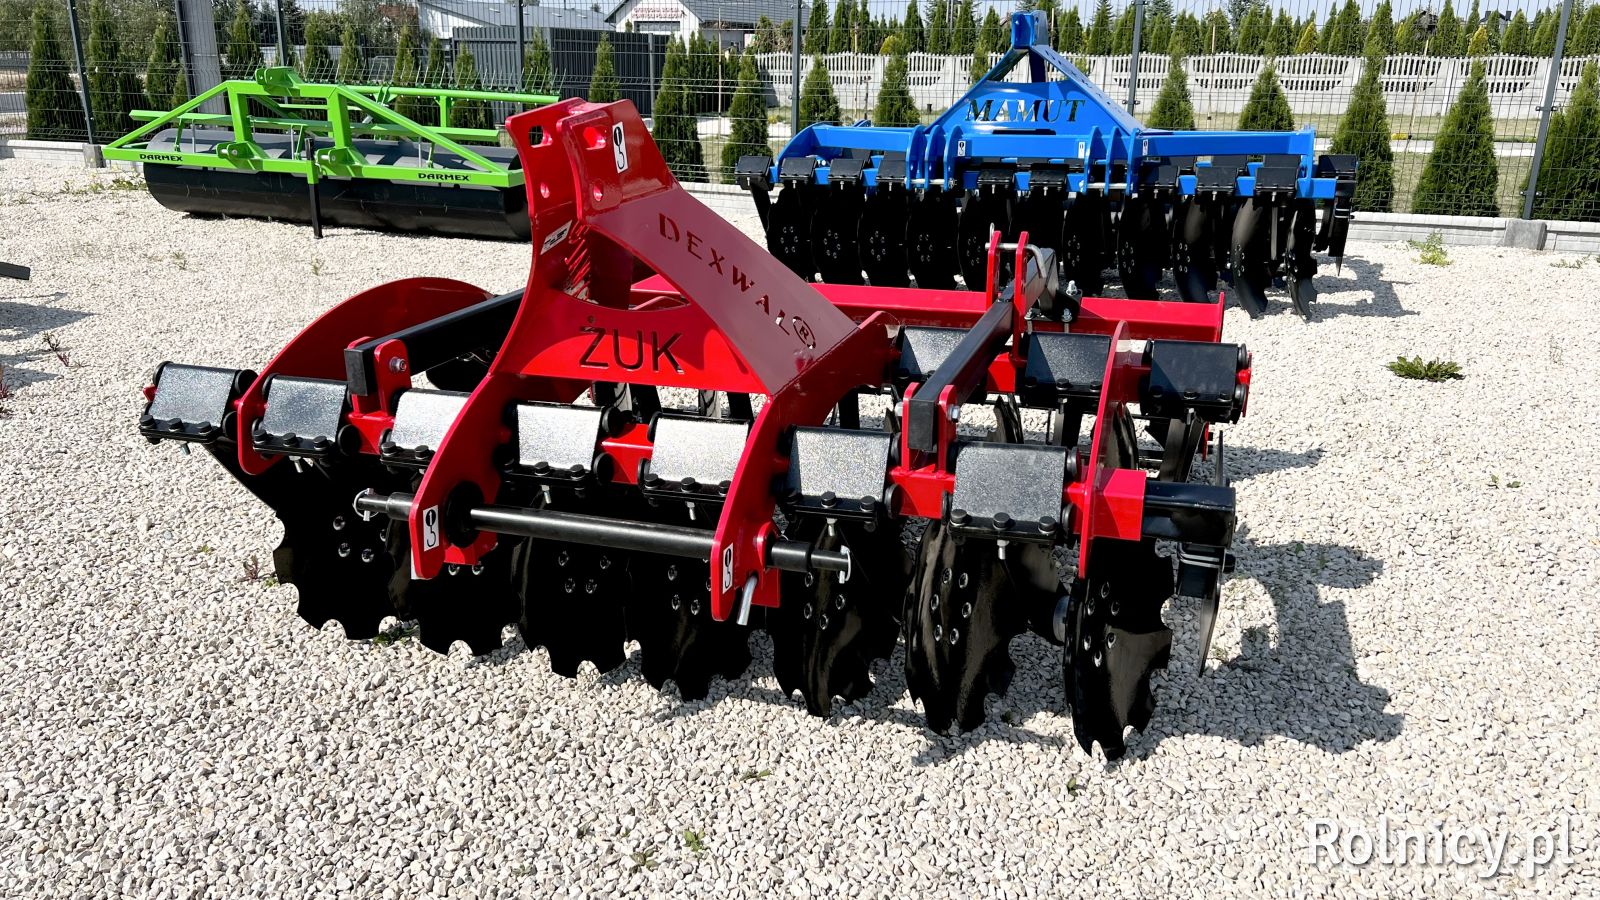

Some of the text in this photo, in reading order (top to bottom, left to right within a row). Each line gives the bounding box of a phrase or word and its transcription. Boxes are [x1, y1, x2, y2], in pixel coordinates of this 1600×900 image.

[964, 99, 1086, 122] MAMUT
[138, 153, 183, 162] DARMEX
[417, 172, 470, 182] DARMEX
[579, 315, 685, 375] ŻUK
